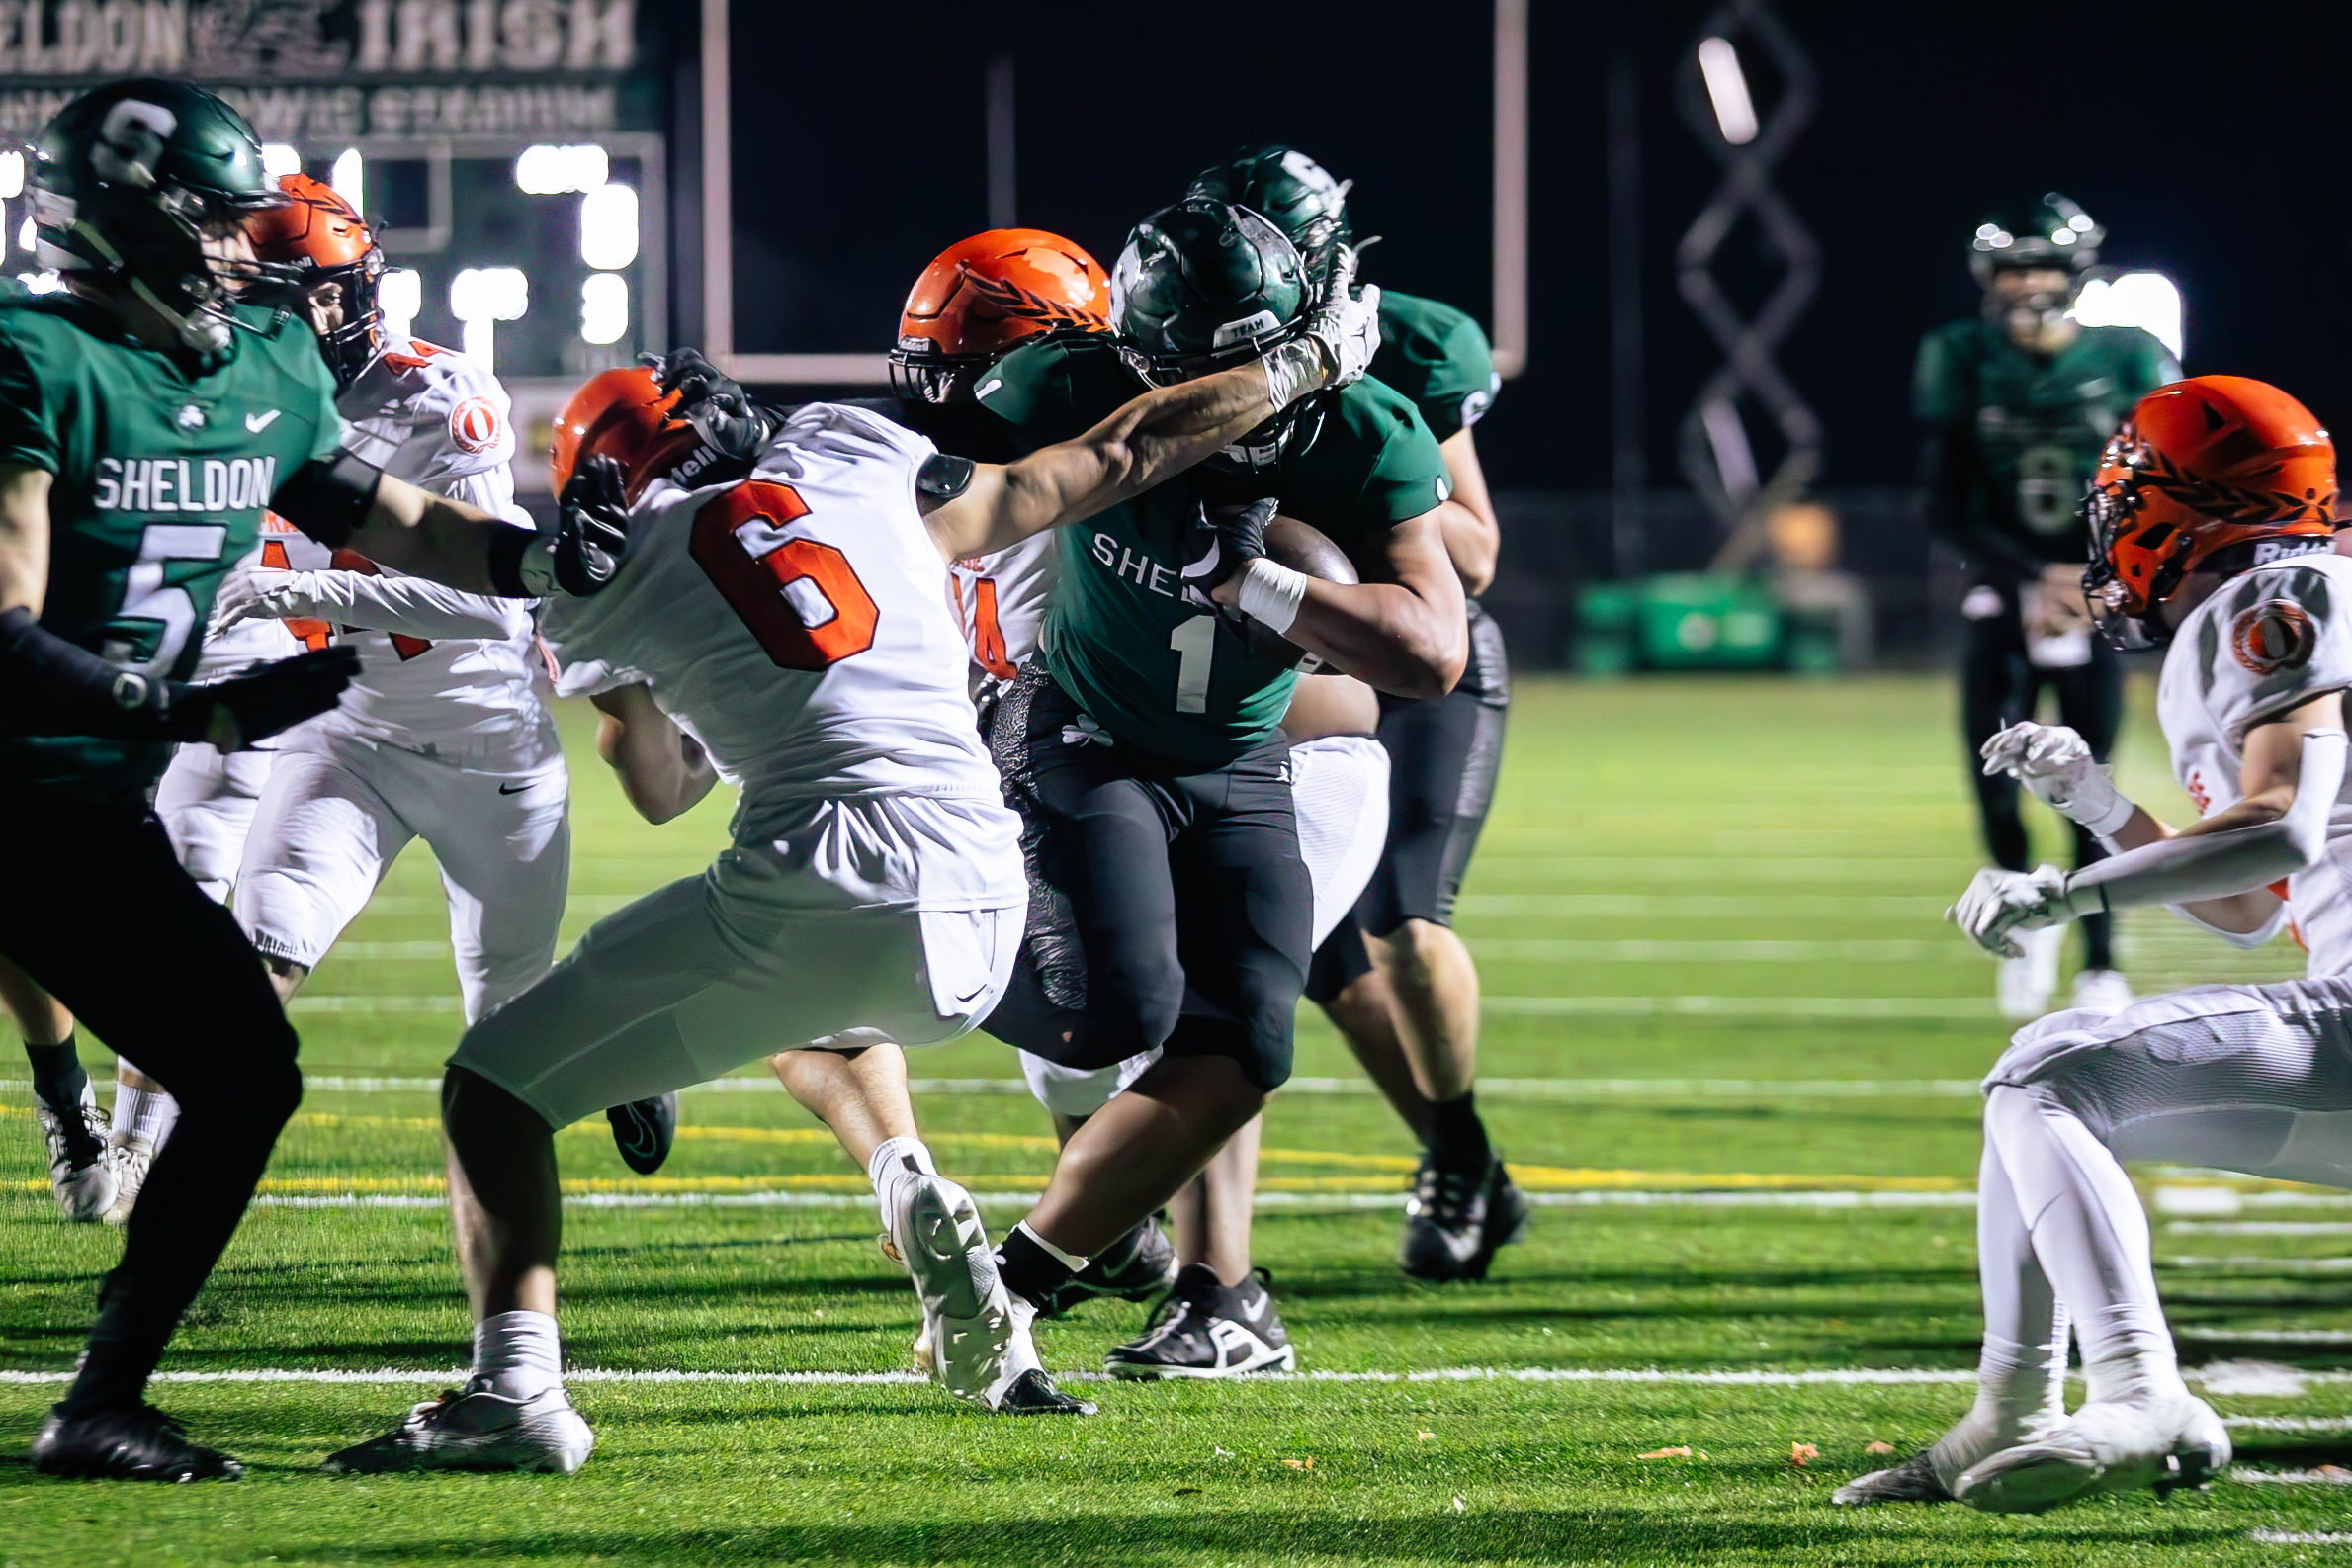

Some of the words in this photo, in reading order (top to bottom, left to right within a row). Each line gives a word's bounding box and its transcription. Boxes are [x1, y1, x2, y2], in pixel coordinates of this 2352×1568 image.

[357, 0, 635, 70] IRISH
[93, 456, 276, 512] SHELDON
[101, 523, 228, 682] 5
[688, 479, 881, 673] 6
[1170, 614, 1216, 714] 1
